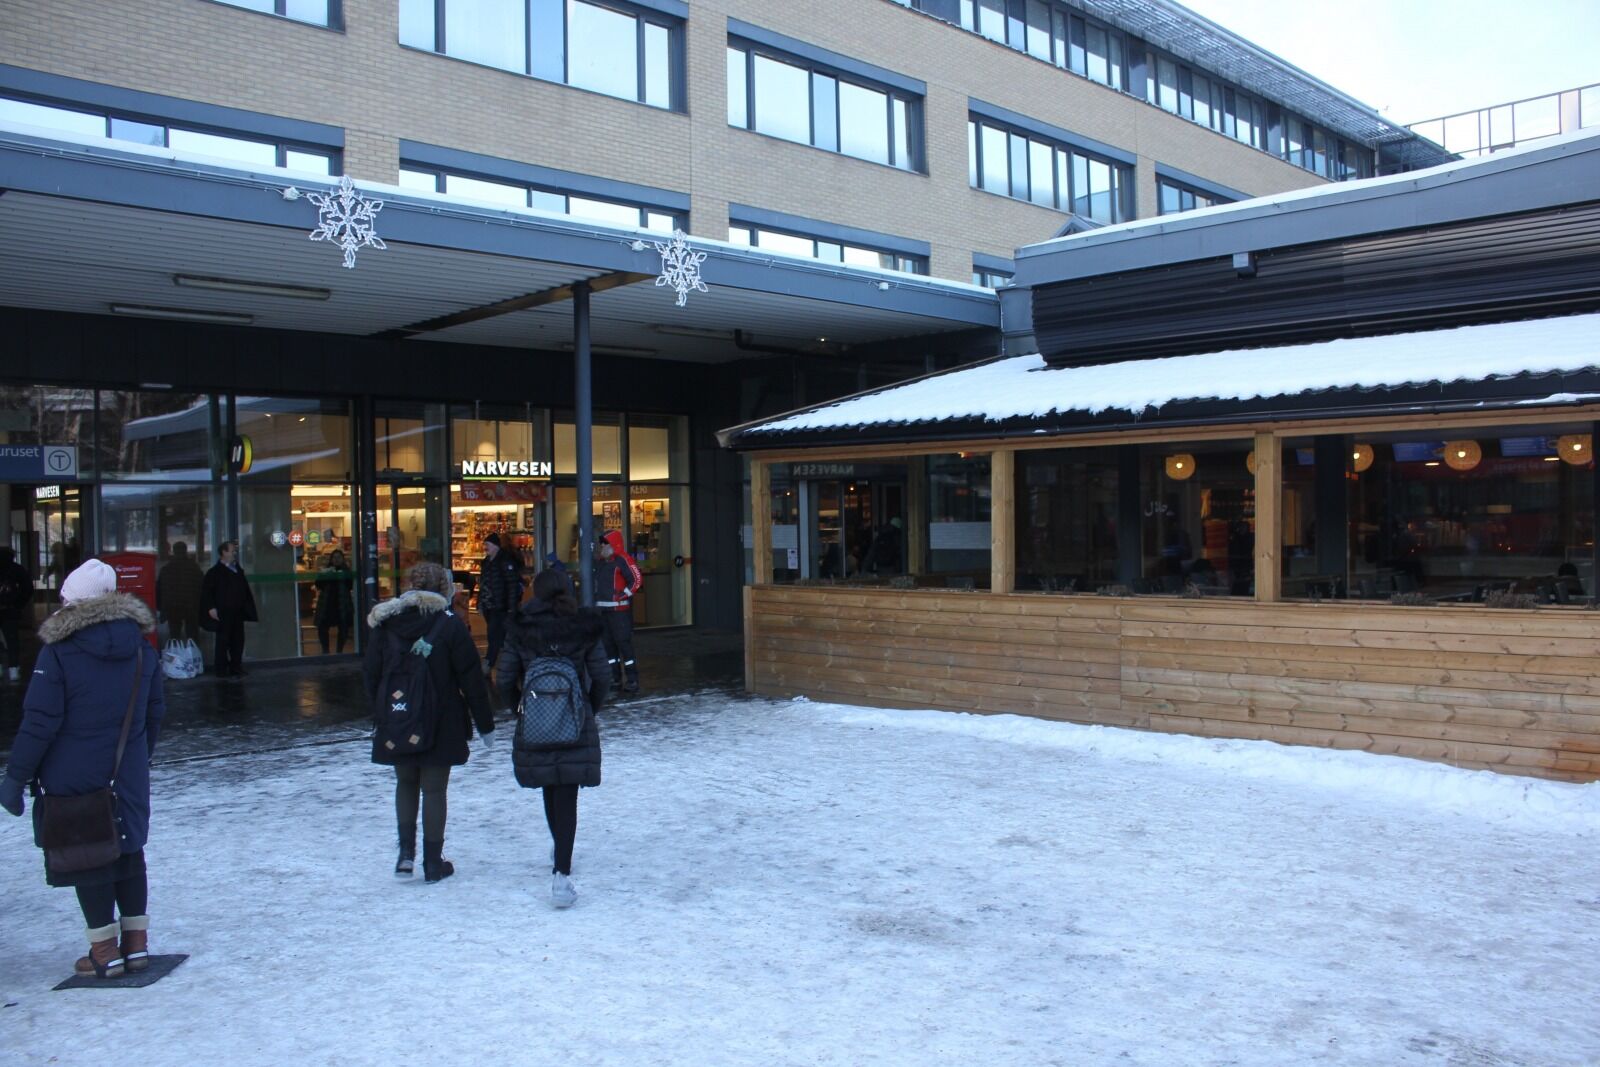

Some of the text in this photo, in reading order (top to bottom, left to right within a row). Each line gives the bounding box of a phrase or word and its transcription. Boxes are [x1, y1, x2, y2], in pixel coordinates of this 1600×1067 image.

[461, 460, 552, 476] NARVESEN
[36, 485, 60, 499] NARVESEN
[592, 487, 610, 497] AFFE
